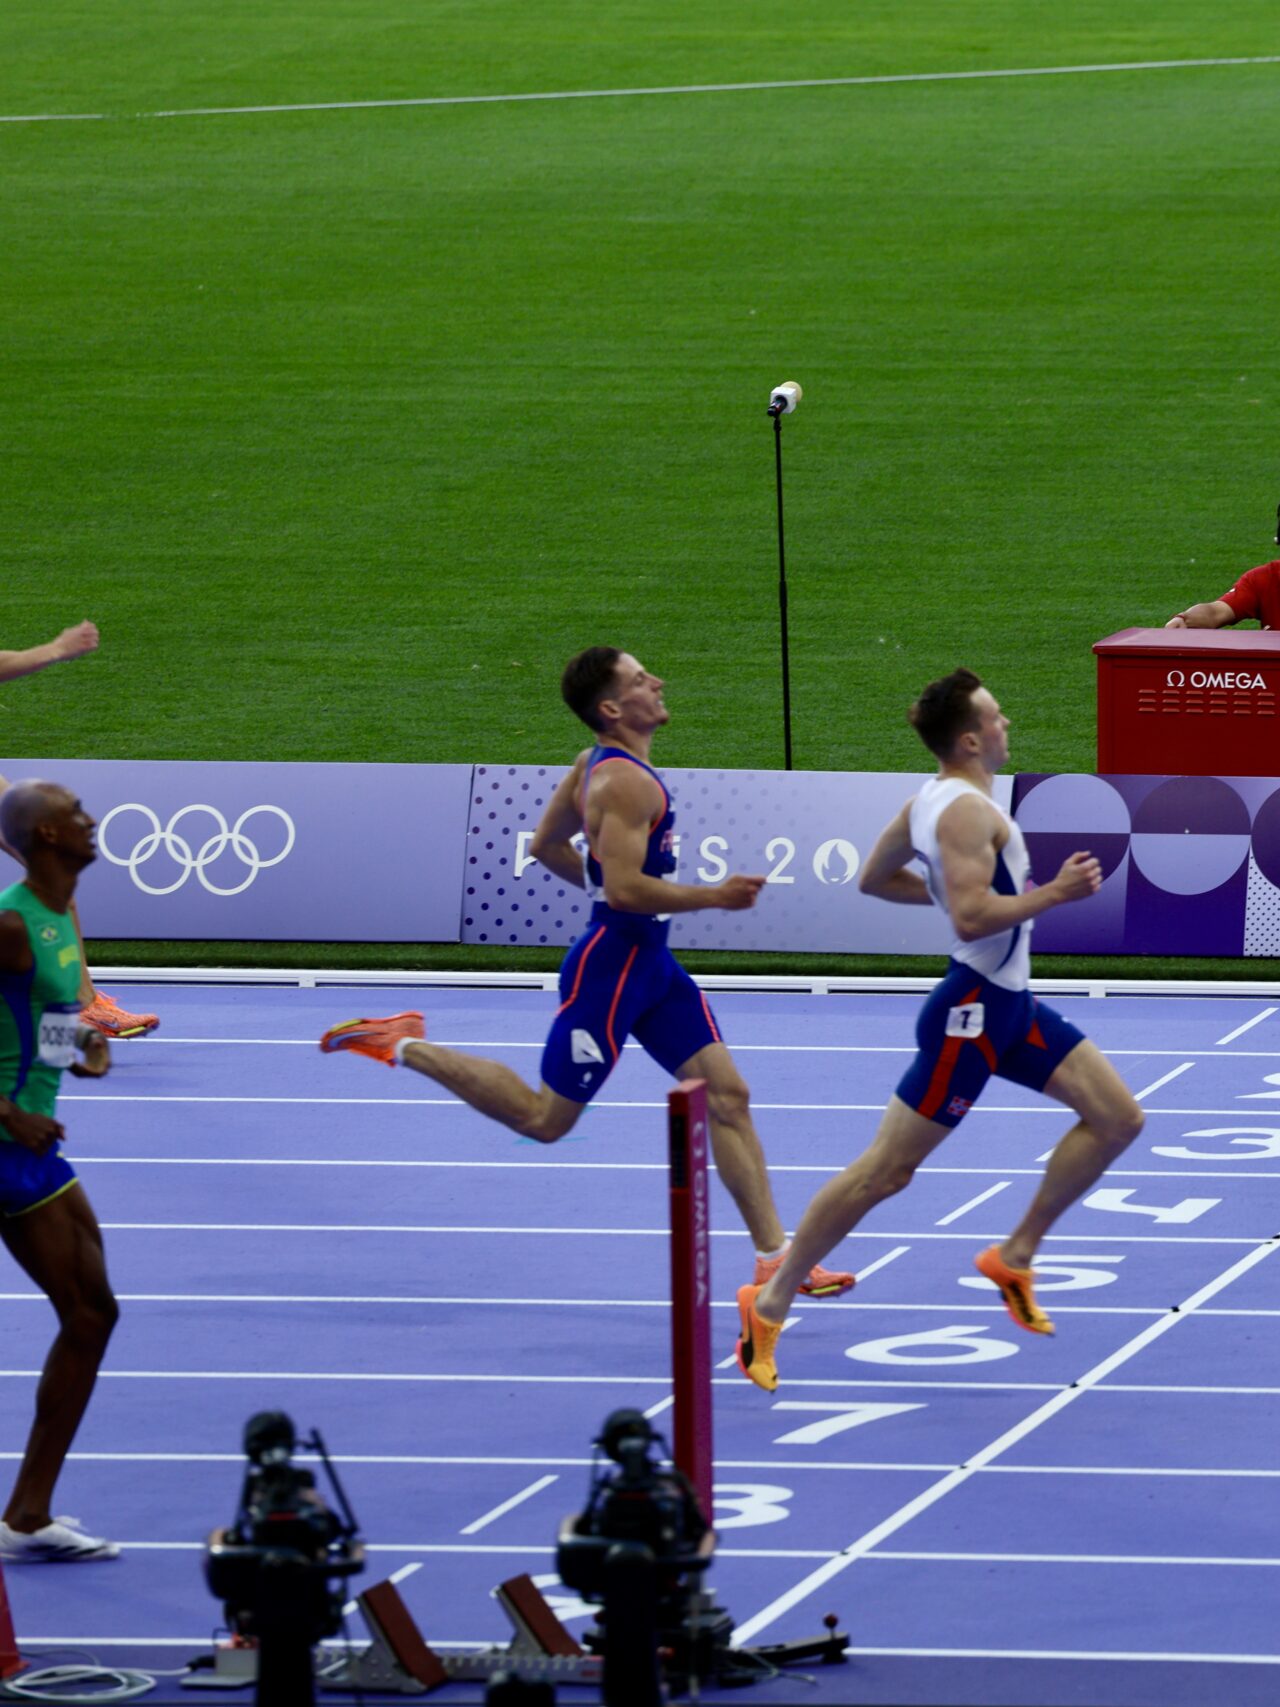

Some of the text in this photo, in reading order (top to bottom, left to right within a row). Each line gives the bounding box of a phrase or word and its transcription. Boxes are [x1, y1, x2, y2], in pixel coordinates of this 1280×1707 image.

[1190, 671, 1267, 690] OMEGA
[1082, 1188, 1222, 1224] 4
[957, 1254, 1126, 1292] 5
[844, 1325, 1020, 1365] 6
[771, 1401, 928, 1444] 7
